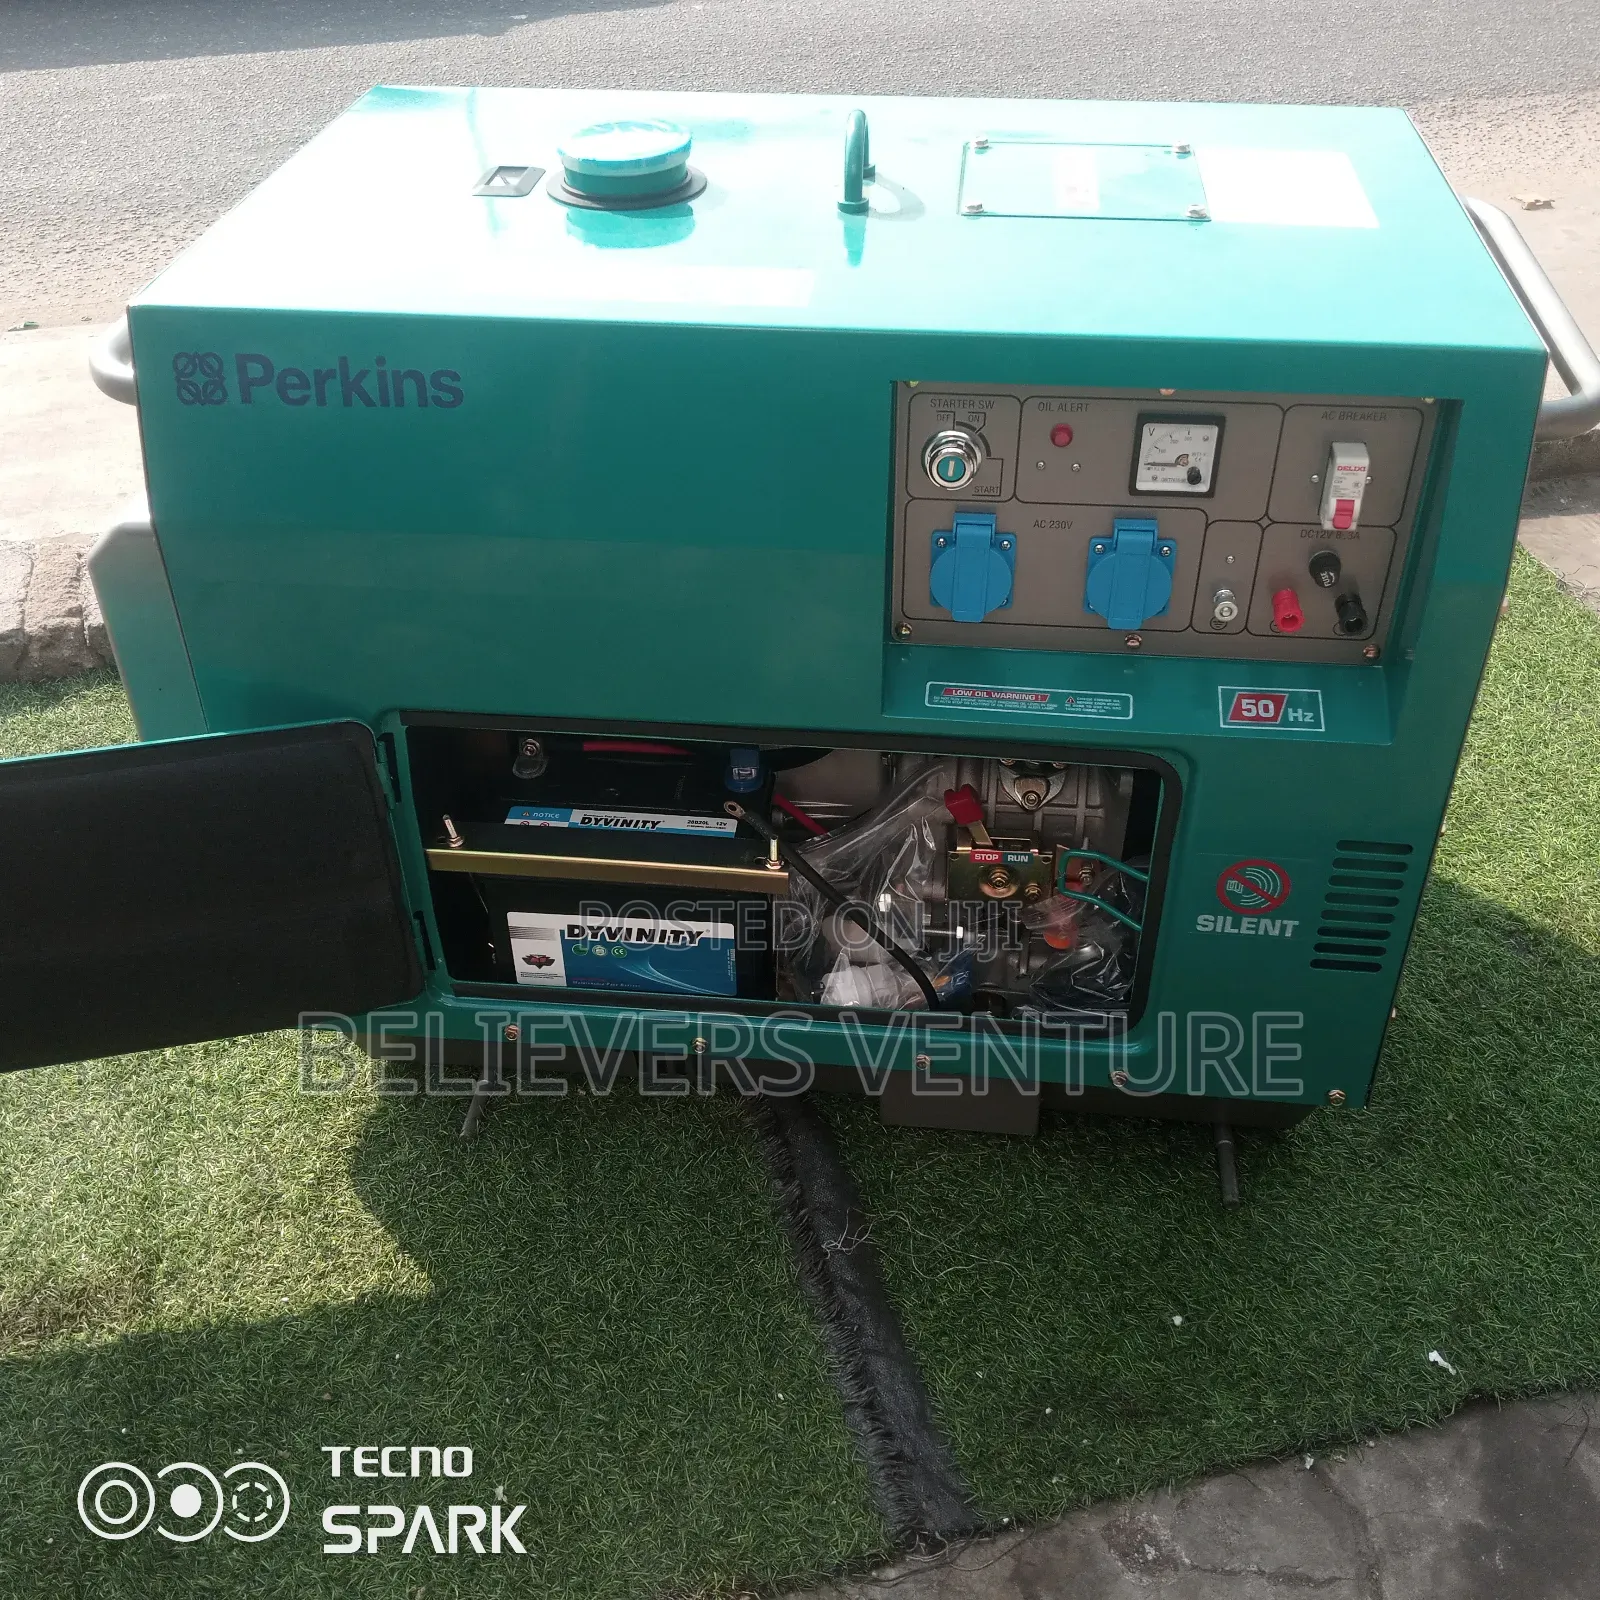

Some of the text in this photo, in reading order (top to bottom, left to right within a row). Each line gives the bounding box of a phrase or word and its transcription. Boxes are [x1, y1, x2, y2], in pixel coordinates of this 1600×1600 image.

[234, 352, 464, 409] Perkins
[930, 398, 995, 410] STARTER SW
[1038, 401, 1091, 413] OIL ALERT
[936, 413, 980, 423] OFF ON
[1321, 410, 1387, 422] AC BREAKER
[974, 485, 1000, 495] START
[1033, 520, 1074, 530] AC 230V
[952, 689, 972, 697] LOW
[975, 690, 990, 698] OIL
[991, 691, 1035, 701] WARNING
[1241, 698, 1315, 722] 50 Hz
[580, 816, 662, 830] DYVINITY
[974, 852, 1029, 862] STOP RUN
[1196, 914, 1300, 937] SILENT
[565, 923, 704, 946] DYVINITY
